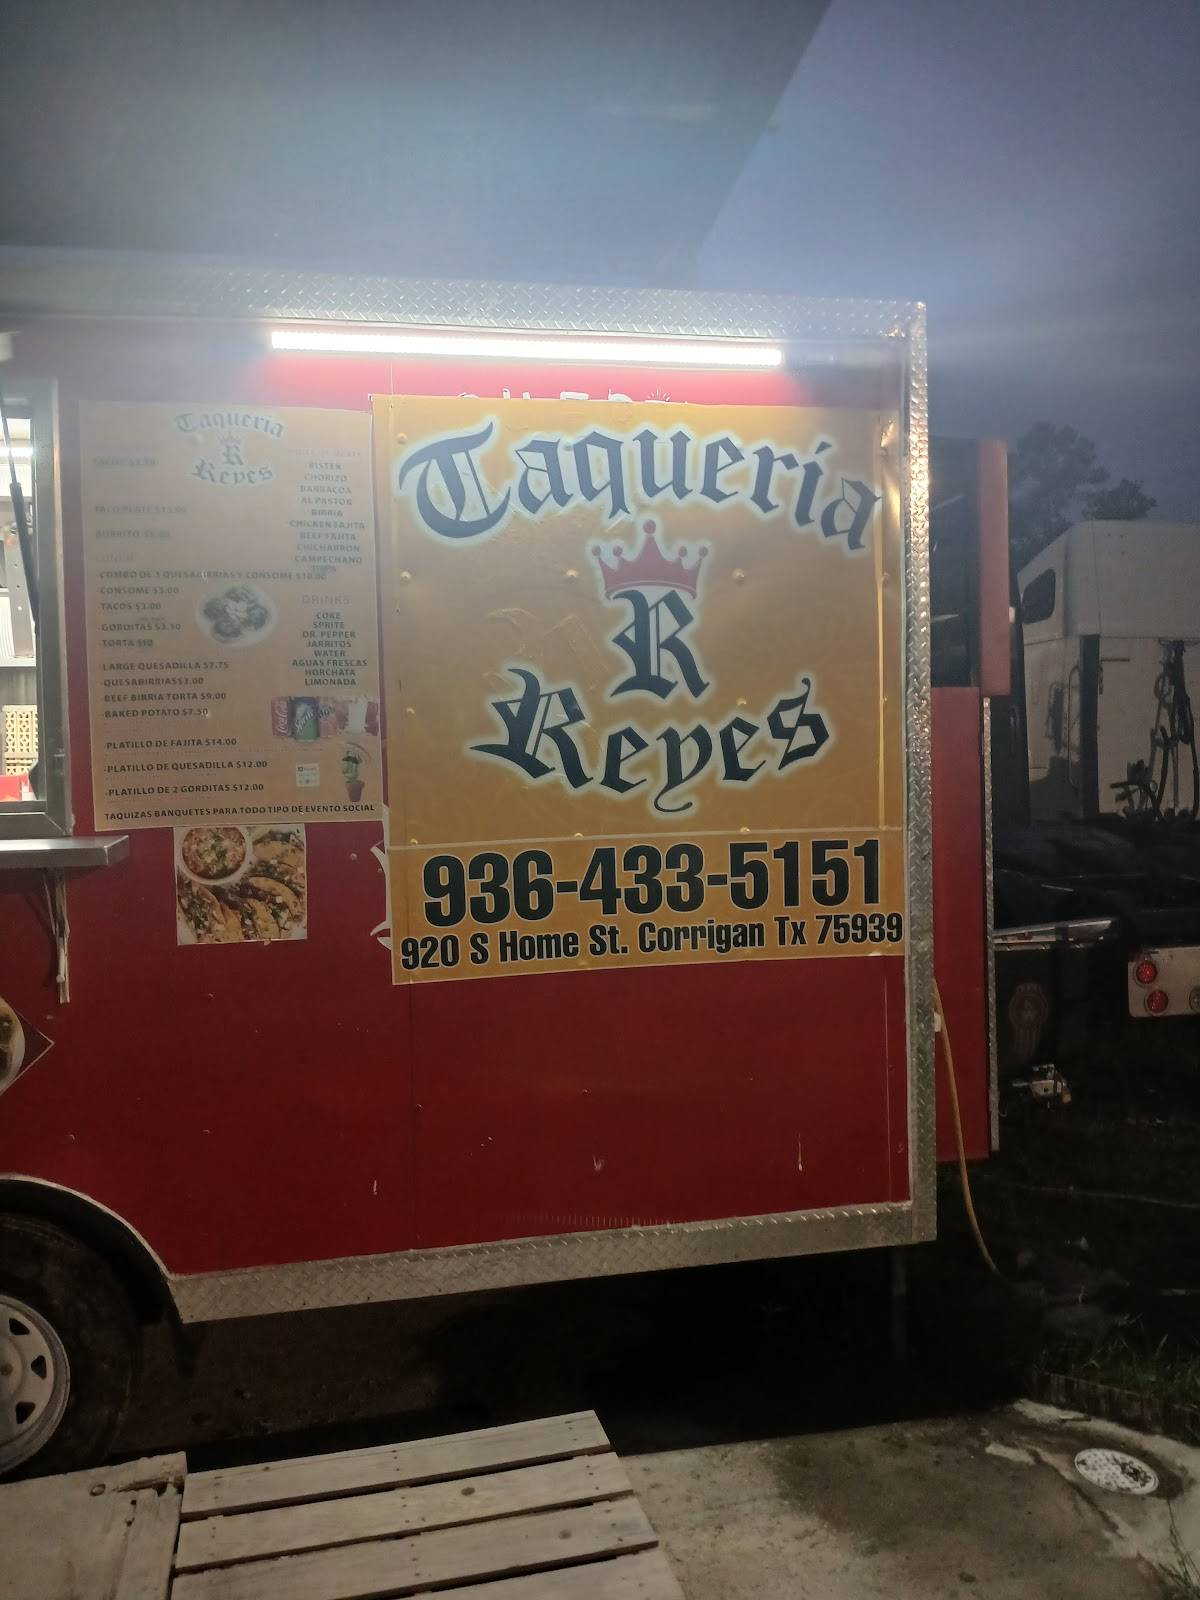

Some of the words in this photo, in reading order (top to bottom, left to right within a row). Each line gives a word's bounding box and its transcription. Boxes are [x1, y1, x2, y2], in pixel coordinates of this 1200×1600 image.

[223, 445, 245, 466] R
[191, 459, 273, 485] Reyes
[304, 473, 348, 482] CHORIZO
[300, 484, 352, 494] BARBACOA
[315, 498, 353, 506] PASTOR
[311, 508, 344, 516] BIRRIA
[289, 519, 332, 528] CHICKEN
[334, 520, 365, 529] FAJITA
[299, 532, 321, 540] BEEF
[325, 532, 356, 541] FAJITA
[296, 543, 360, 552] CHICHARRON
[294, 555, 363, 564] CAMPECHANO
[99, 570, 137, 579] COMBO
[139, 571, 153, 579] DE
[246, 571, 293, 580] CONSOME
[99, 586, 150, 595] CONSOME
[301, 594, 351, 605] DRINKS
[100, 602, 132, 610] TACOS
[101, 623, 153, 631] GORDITAS
[313, 621, 345, 629] SPRITE
[320, 630, 356, 638] PEPPER
[101, 639, 135, 647] TORTA
[306, 640, 352, 648] JARRITOS
[610, 589, 711, 699] R
[313, 649, 346, 657] WATER
[103, 663, 136, 671] LARGE
[138, 661, 201, 671] QUESADILLA
[203, 661, 229, 669] $7.75
[291, 659, 324, 667] AGUAS
[326, 659, 368, 667] FRESCAS
[304, 668, 356, 676] HORCHATA
[304, 678, 357, 686] LIMONADA
[104, 694, 129, 702] BEEF
[131, 693, 164, 702] BIRRIA
[167, 693, 198, 701] TORTA
[200, 692, 227, 701] $9.00
[104, 709, 139, 718] BAKED
[141, 708, 180, 717] POTATO
[106, 740, 153, 750] PLATILLO
[155, 739, 169, 748] DE
[170, 738, 203, 748] FAJITA
[205, 737, 237, 746] $14.00
[469, 667, 831, 812] Reyes
[107, 763, 154, 773] PLATILLO
[156, 763, 170, 771] DE
[171, 760, 234, 772] QUESADILLA
[236, 760, 268, 769] $12.00
[108, 786, 155, 797] PLATILLO
[157, 786, 171, 794] DE
[172, 785, 178, 794] 2
[180, 784, 230, 793] GORDITAS
[232, 783, 264, 792] $12.00
[104, 810, 152, 821] TAQUIZAS
[154, 808, 211, 818] BANQUETES
[212, 807, 238, 816] PARA
[240, 806, 266, 815] TODO
[267, 806, 290, 814] TIPO
[291, 805, 304, 814] DE
[305, 804, 341, 813] EVENTO
[343, 804, 375, 812] SOCIAL
[422, 837, 881, 927] 936-433-5151
[400, 935, 460, 970] 920
[470, 932, 489, 965] S
[499, 928, 579, 963] Home
[589, 922, 628, 957] St.
[638, 917, 766, 958] Corrigan
[774, 915, 807, 947] Tx
[816, 912, 903, 945] 75939
